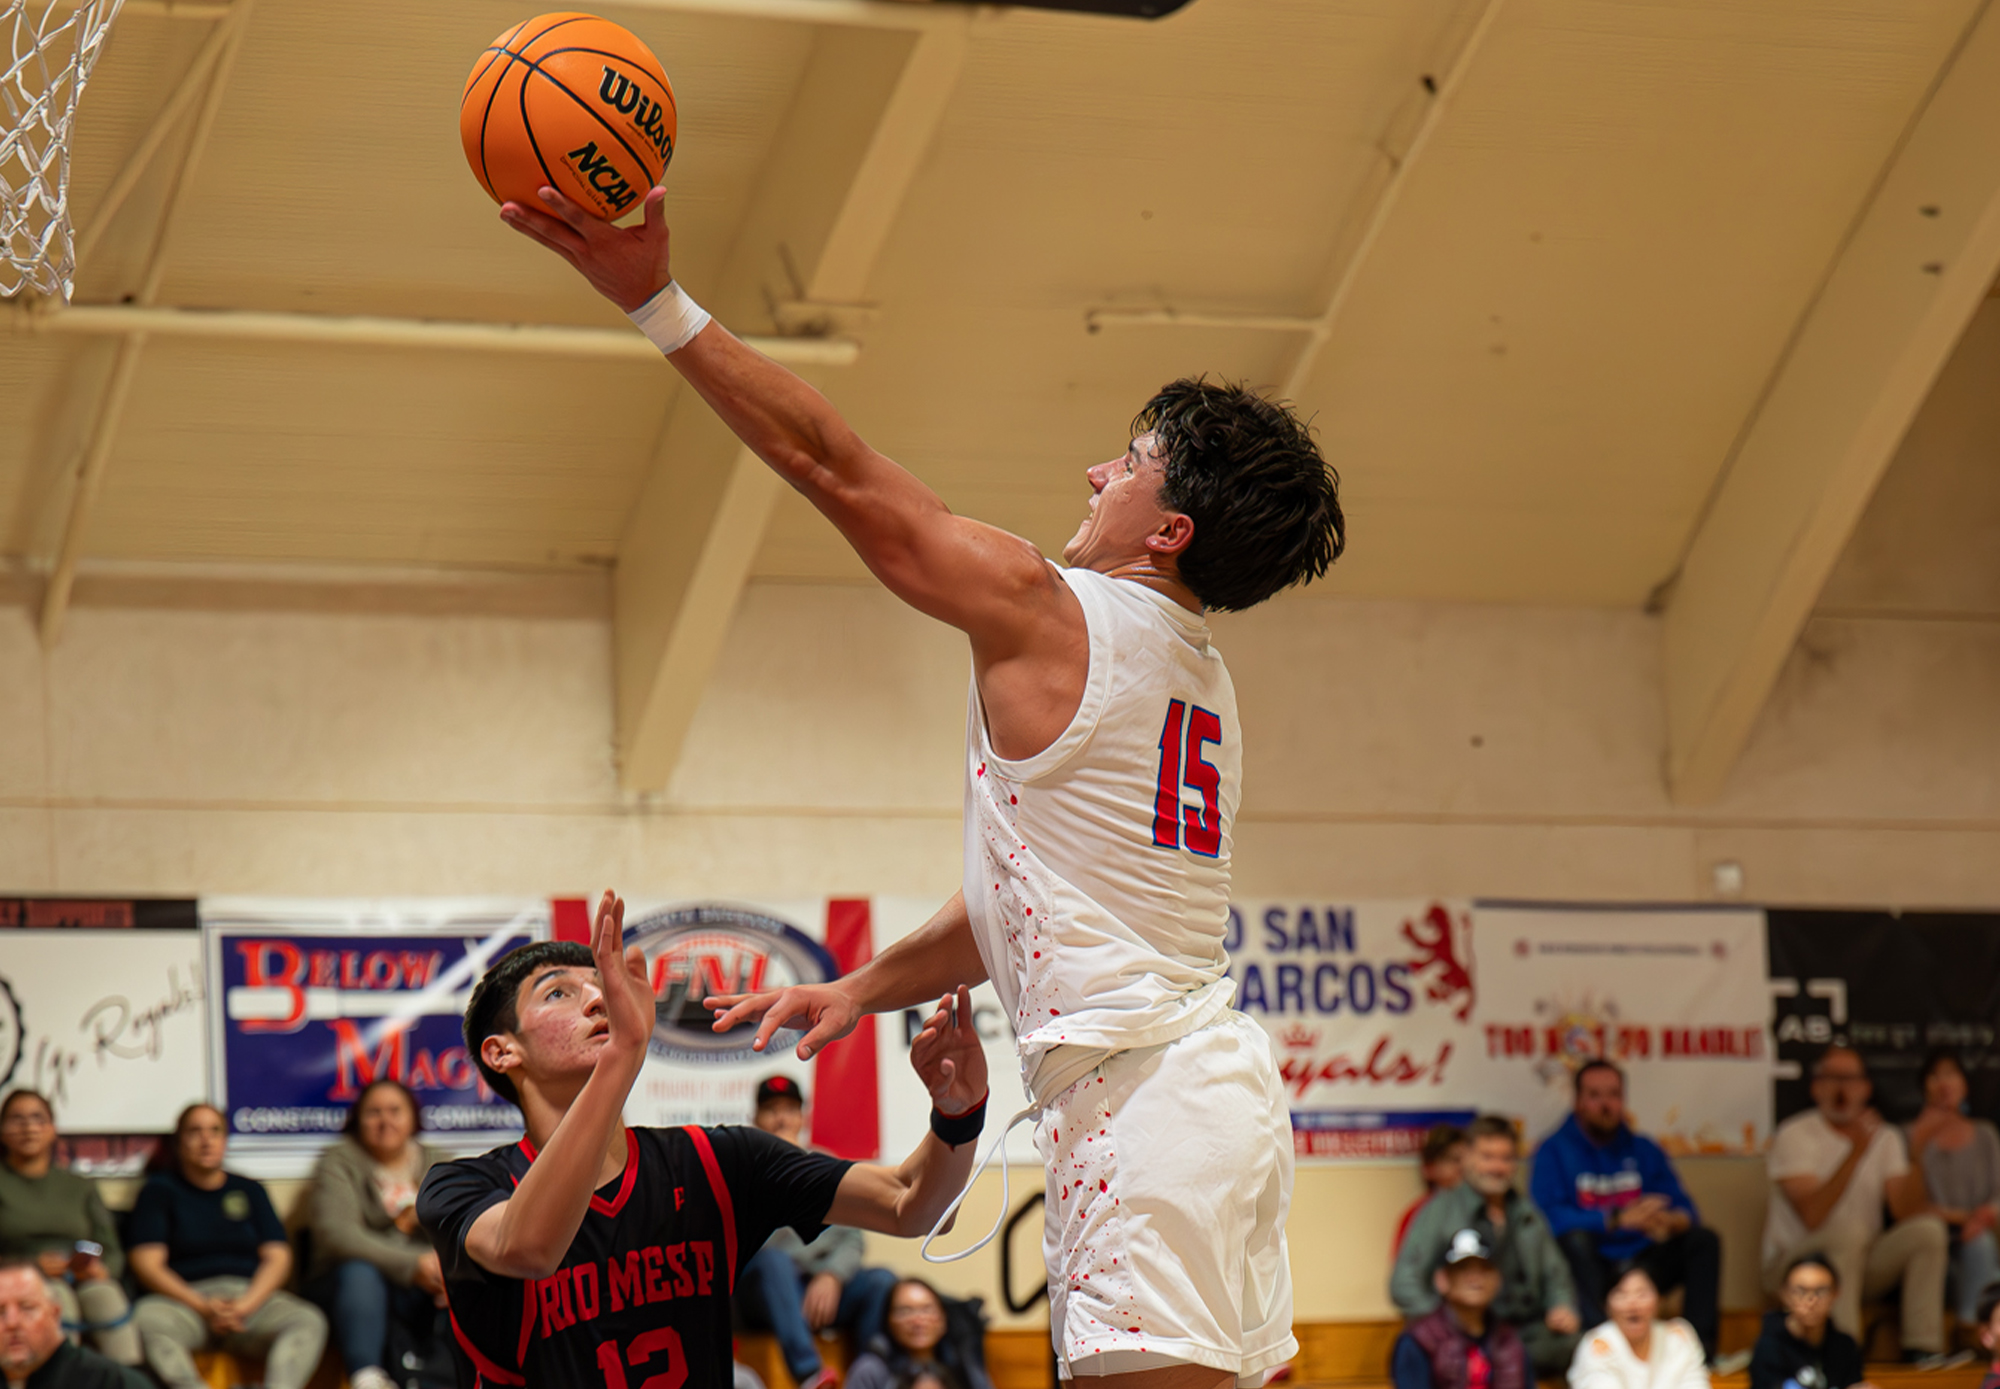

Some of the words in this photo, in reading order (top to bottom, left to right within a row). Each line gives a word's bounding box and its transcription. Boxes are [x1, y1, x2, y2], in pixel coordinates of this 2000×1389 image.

[567, 141, 638, 212] NCAA
[1152, 698, 1222, 858] 15
[1264, 907, 1354, 953] SAN
[236, 939, 443, 1034] BELOW
[651, 952, 790, 999] FNL
[1226, 963, 1415, 1015] ARCOS
[537, 1262, 600, 1339] RIO
